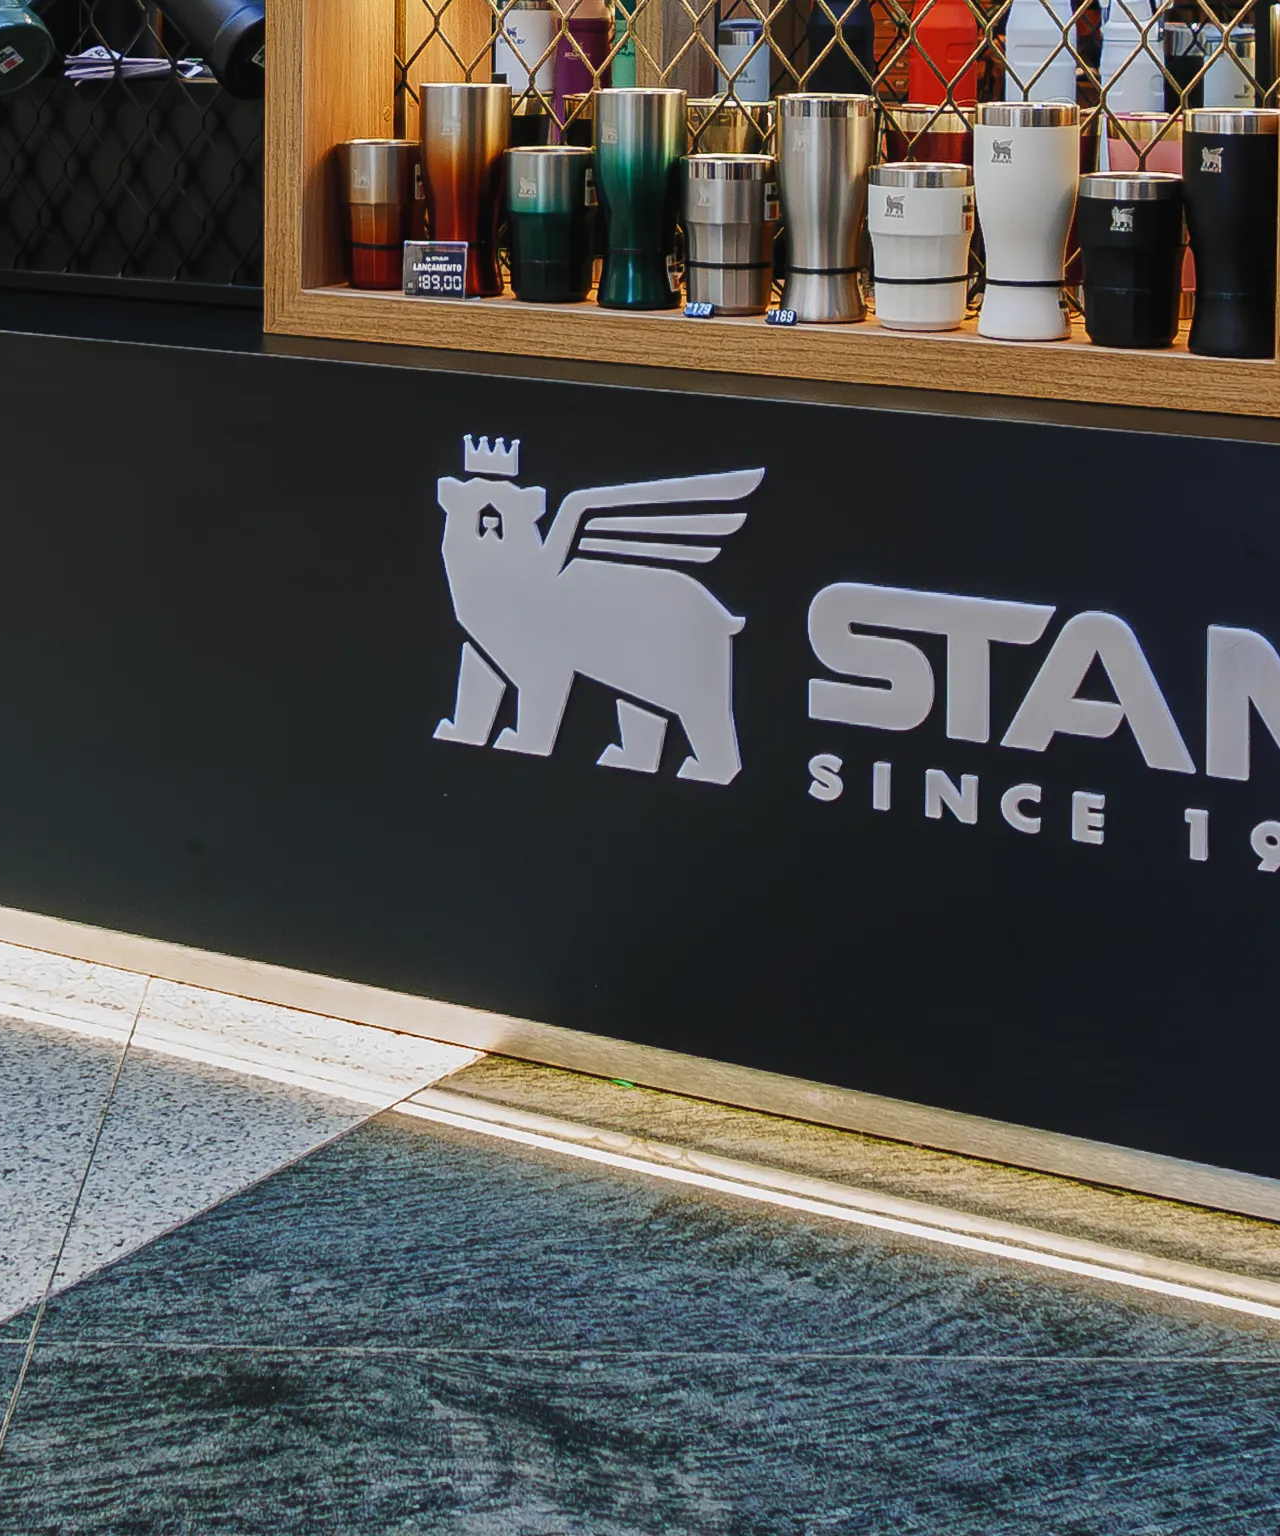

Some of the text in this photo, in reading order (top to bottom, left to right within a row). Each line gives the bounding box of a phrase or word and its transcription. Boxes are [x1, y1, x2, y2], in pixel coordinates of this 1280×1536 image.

[412, 262, 463, 273] LANÇAMENTO
[418, 275, 462, 292] 189,00
[808, 753, 1105, 845] SINCE
